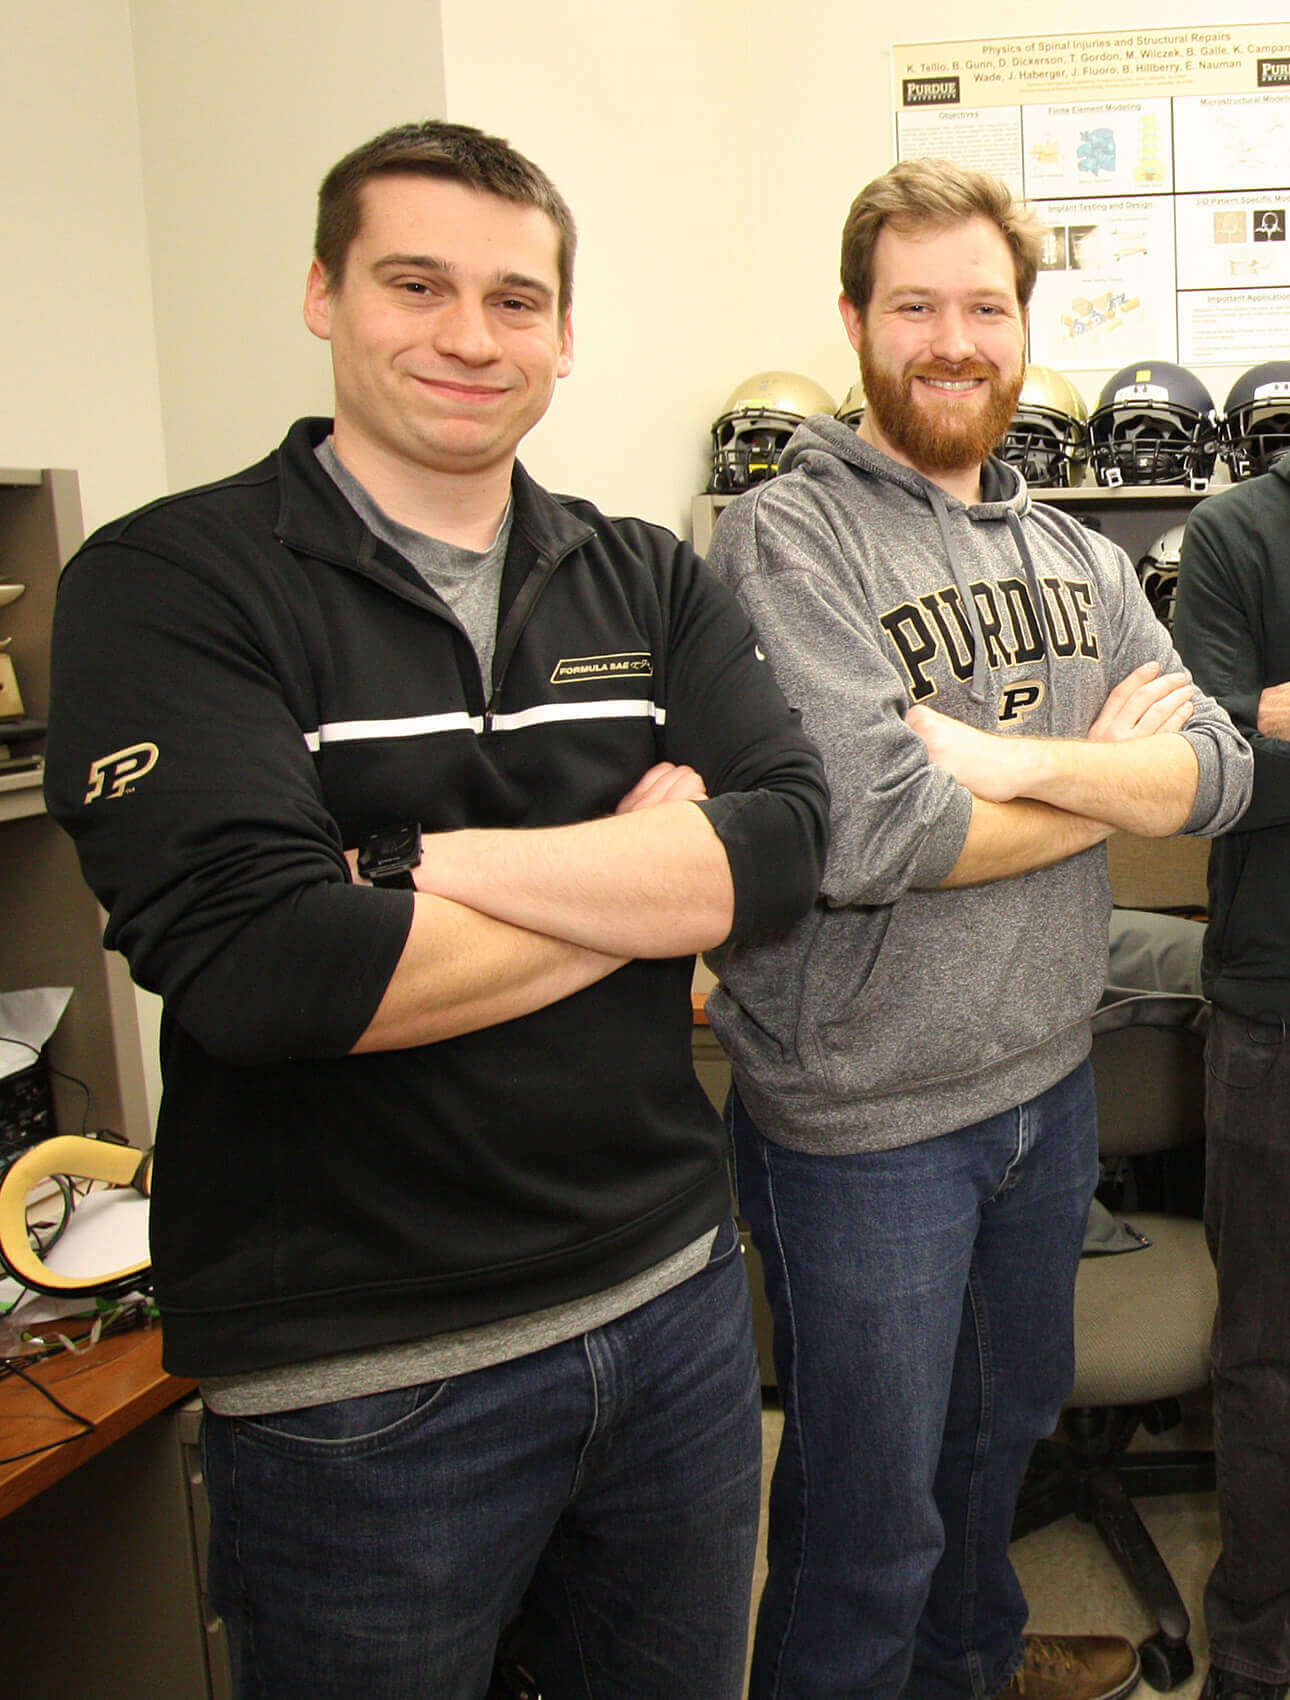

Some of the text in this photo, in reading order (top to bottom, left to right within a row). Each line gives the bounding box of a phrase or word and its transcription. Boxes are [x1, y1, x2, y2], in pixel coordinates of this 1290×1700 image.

[982, 32, 1231, 56] Physics of Spinal Injuries and Structural Repairs
[1080, 51, 1122, 62] Gordon,
[1199, 59, 1242, 70] Nauman
[907, 82, 956, 96] PURDUE
[879, 577, 1100, 703] PURDUE
[559, 661, 629, 676] FORMULA SAE
[997, 680, 1046, 728] P
[83, 742, 159, 805] P
